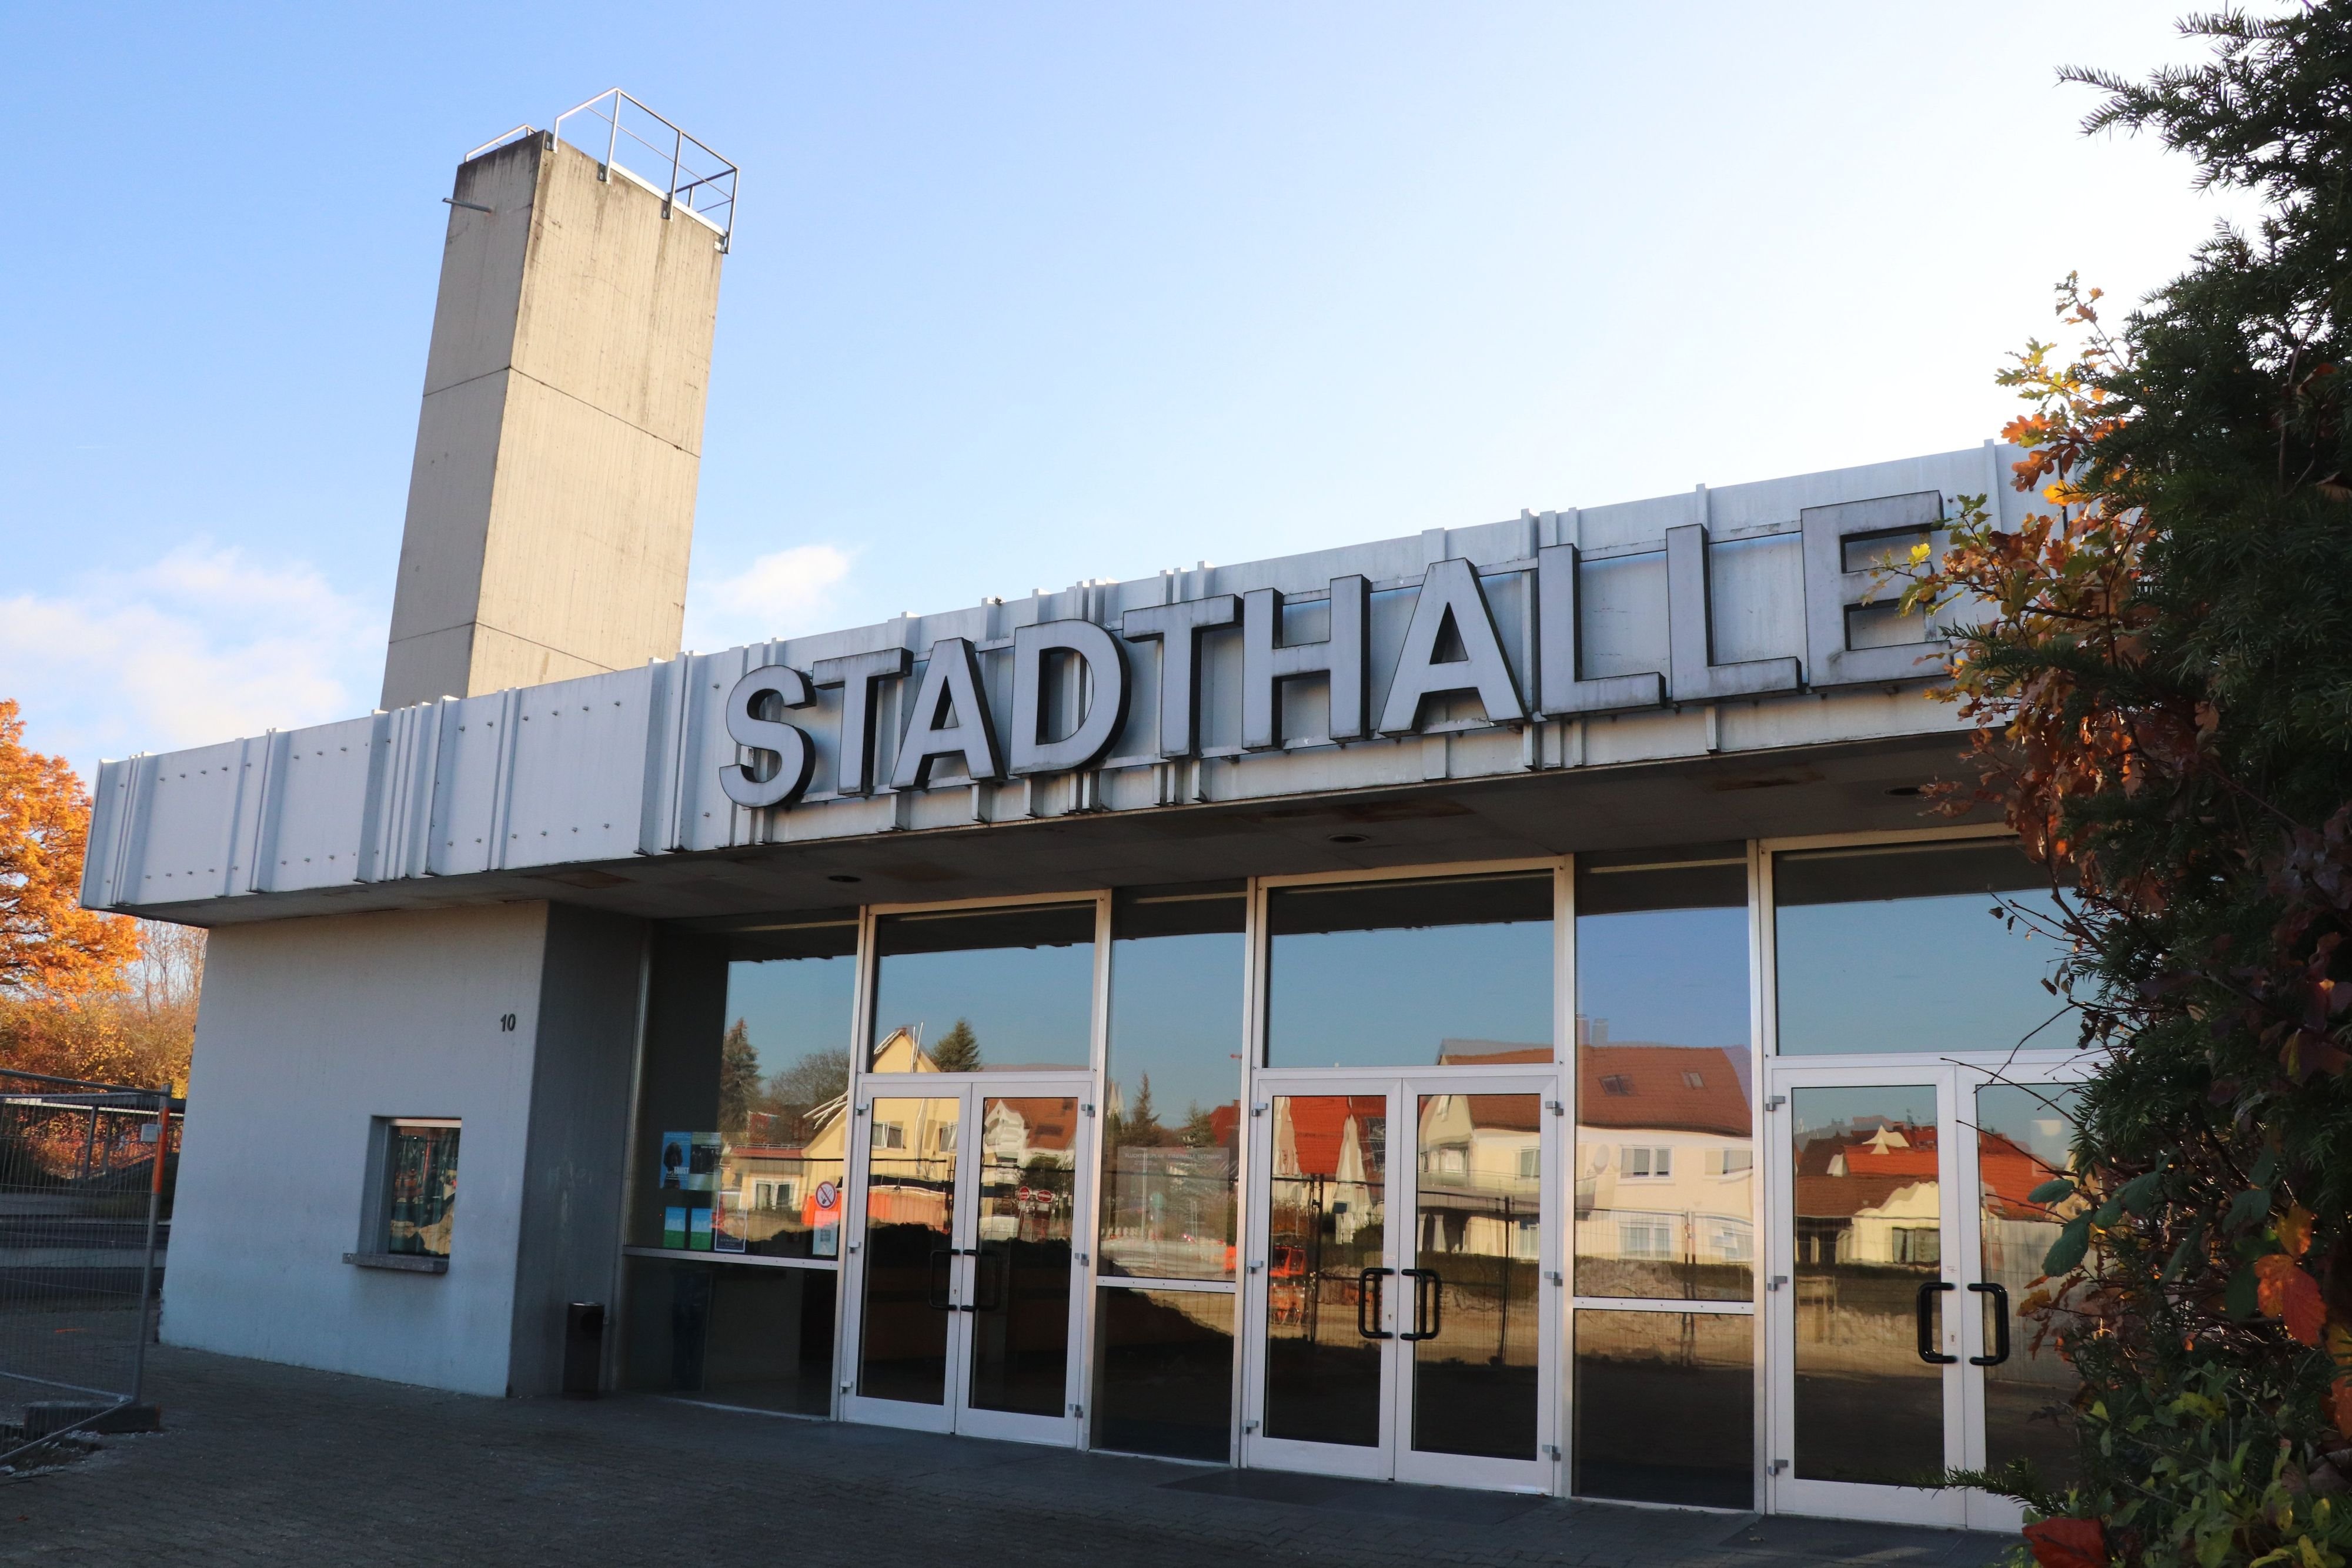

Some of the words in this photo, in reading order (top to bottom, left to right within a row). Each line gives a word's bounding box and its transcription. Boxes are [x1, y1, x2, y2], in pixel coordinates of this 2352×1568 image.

[719, 490, 1953, 809] STADTHALLE
[500, 1013, 516, 1032] 10
[674, 1166, 690, 1175] FAUST
